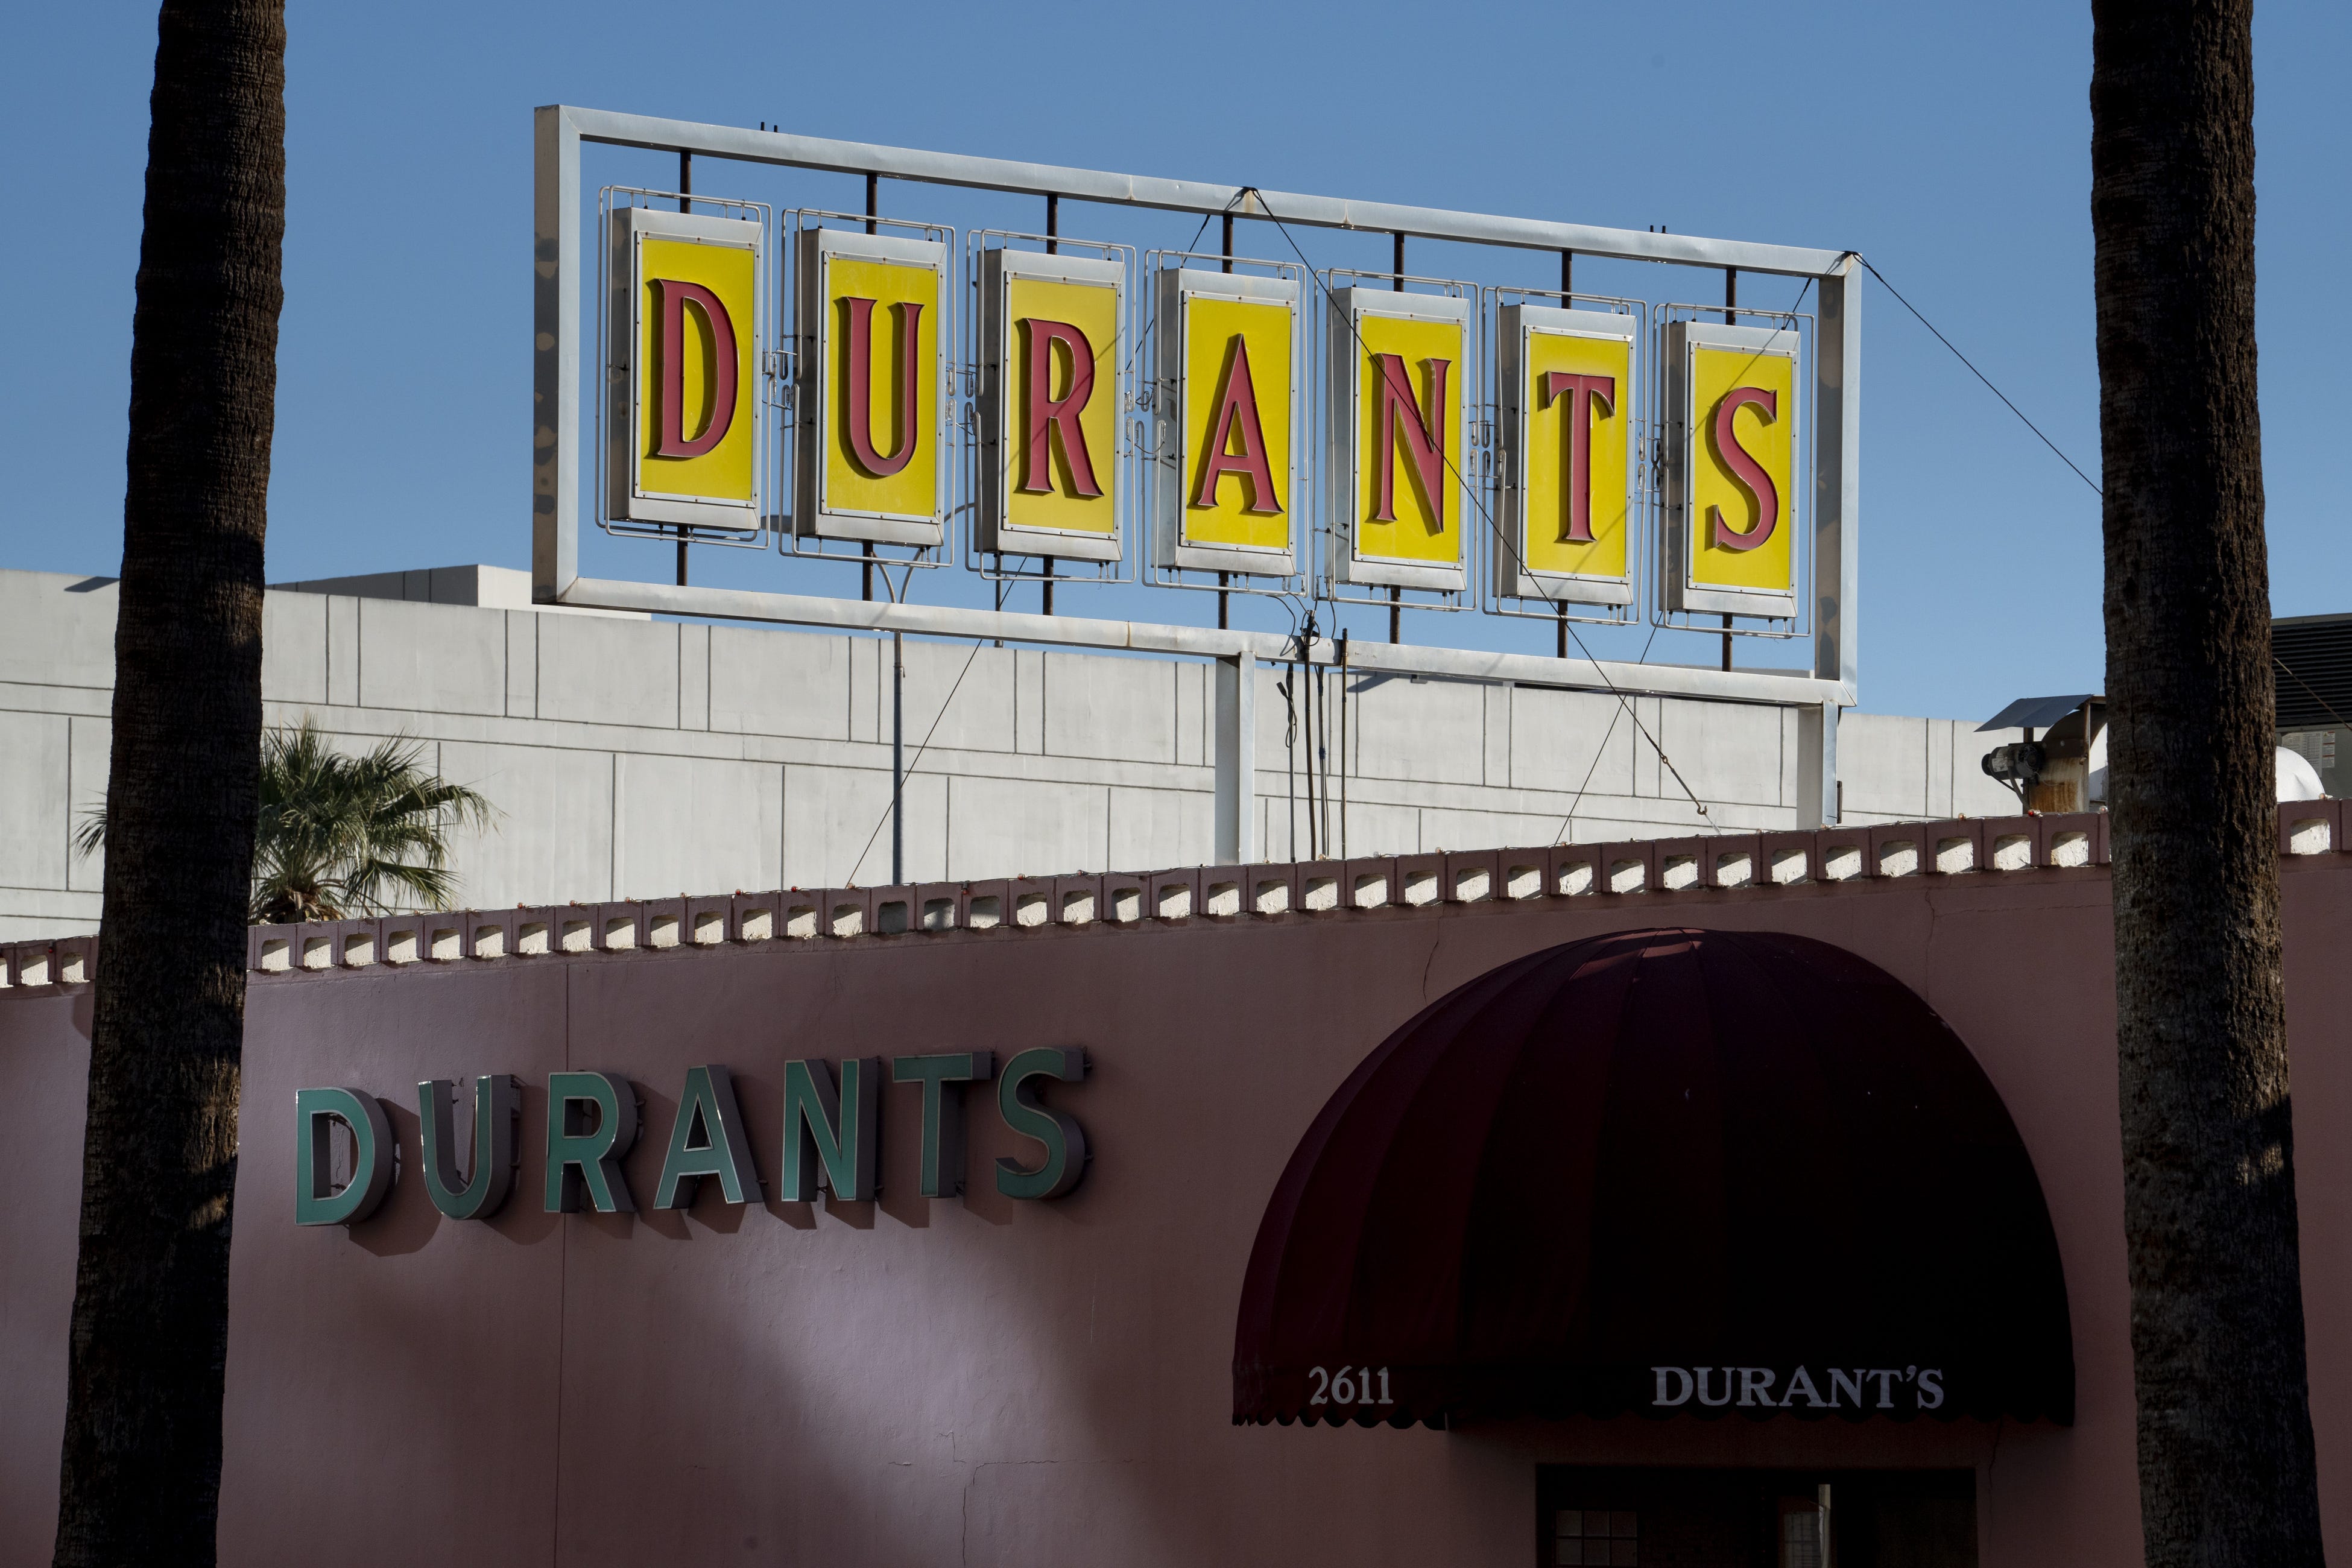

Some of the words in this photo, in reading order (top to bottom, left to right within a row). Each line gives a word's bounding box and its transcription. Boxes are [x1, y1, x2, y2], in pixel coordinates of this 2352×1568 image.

[650, 279, 1780, 551] DURANTS
[296, 1048, 1086, 1226] DURANTS
[1309, 1365, 1394, 1405] 2611
[1651, 1365, 1944, 1409] DURANT'S
